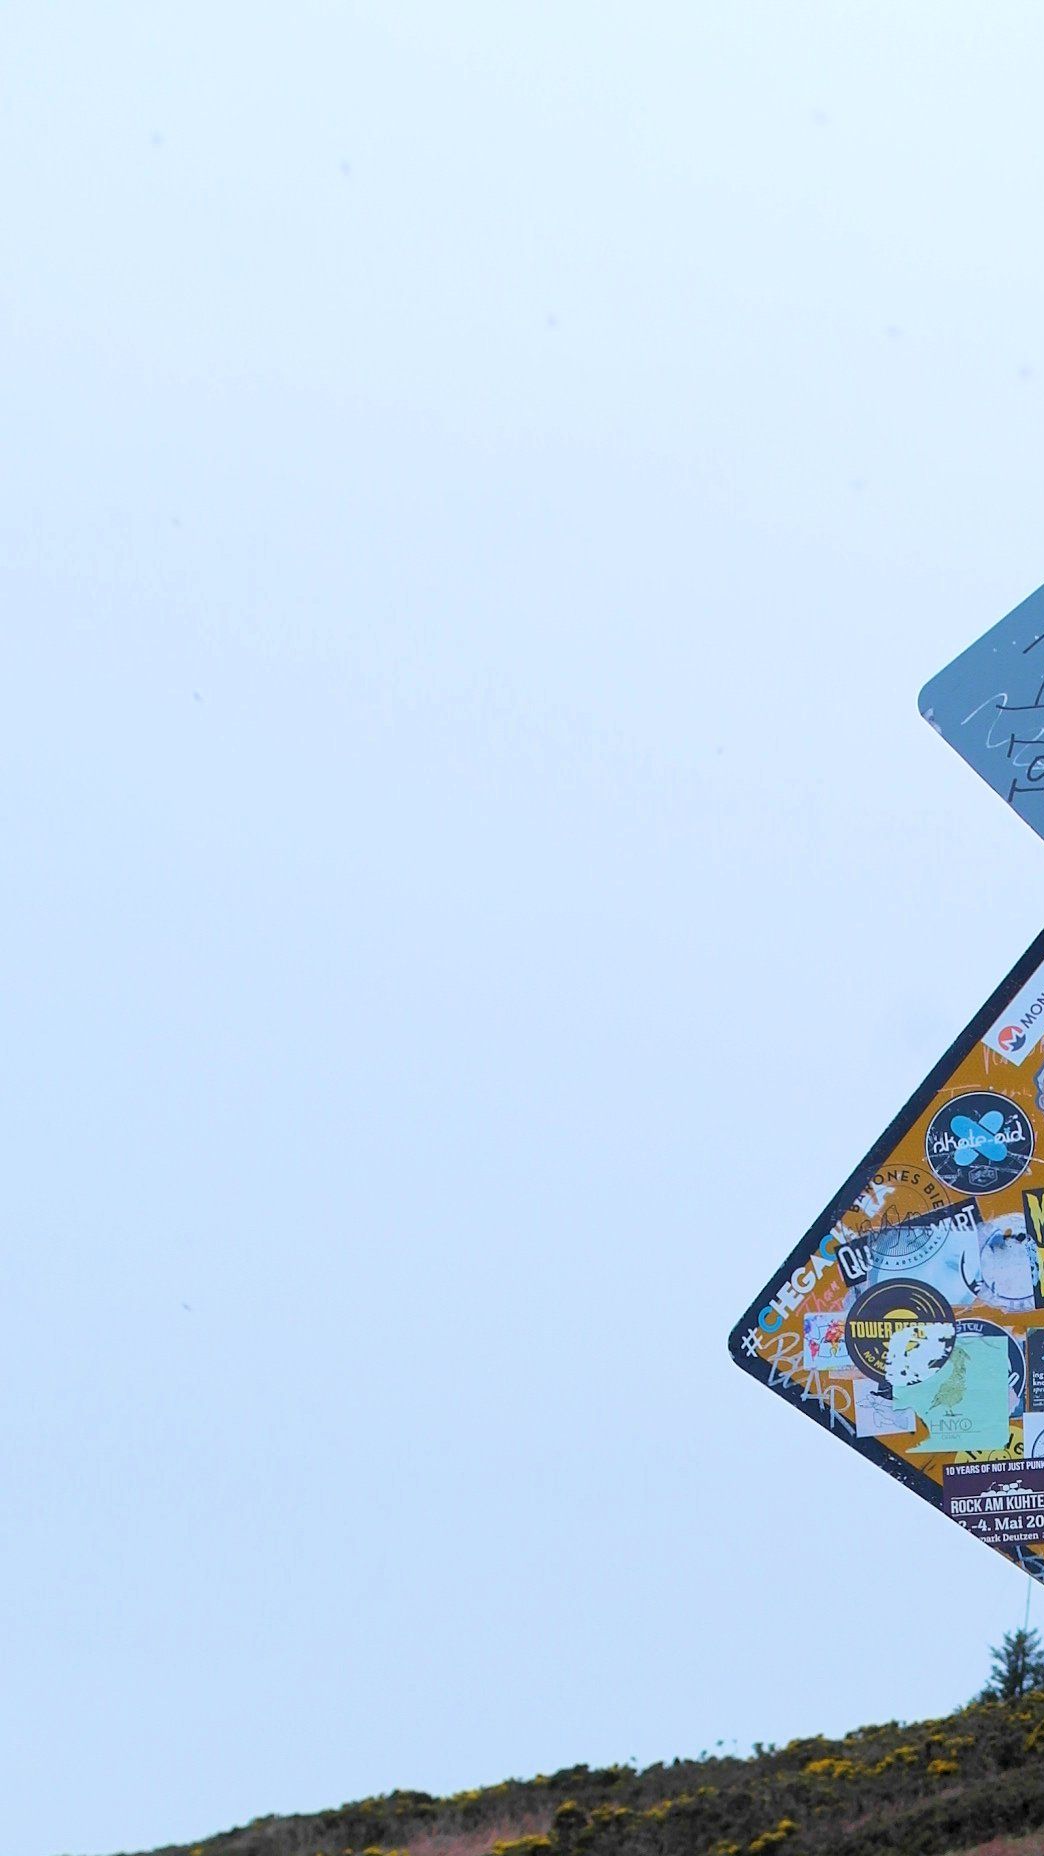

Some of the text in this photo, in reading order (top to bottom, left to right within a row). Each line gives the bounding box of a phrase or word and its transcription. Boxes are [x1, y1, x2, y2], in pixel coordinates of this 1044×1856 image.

[849, 1321, 892, 1338] TOWER
[945, 1466, 954, 1476] 10
[956, 1465, 980, 1475] YEARS
[981, 1464, 990, 1473] OF
[992, 1463, 1006, 1472] NOT
[1008, 1462, 1025, 1472] JUST
[951, 1498, 982, 1514] ROCK
[985, 1497, 1004, 1511] AM
[994, 1516, 1023, 1531] Mai
[1002, 1532, 1040, 1543] Deutzen
